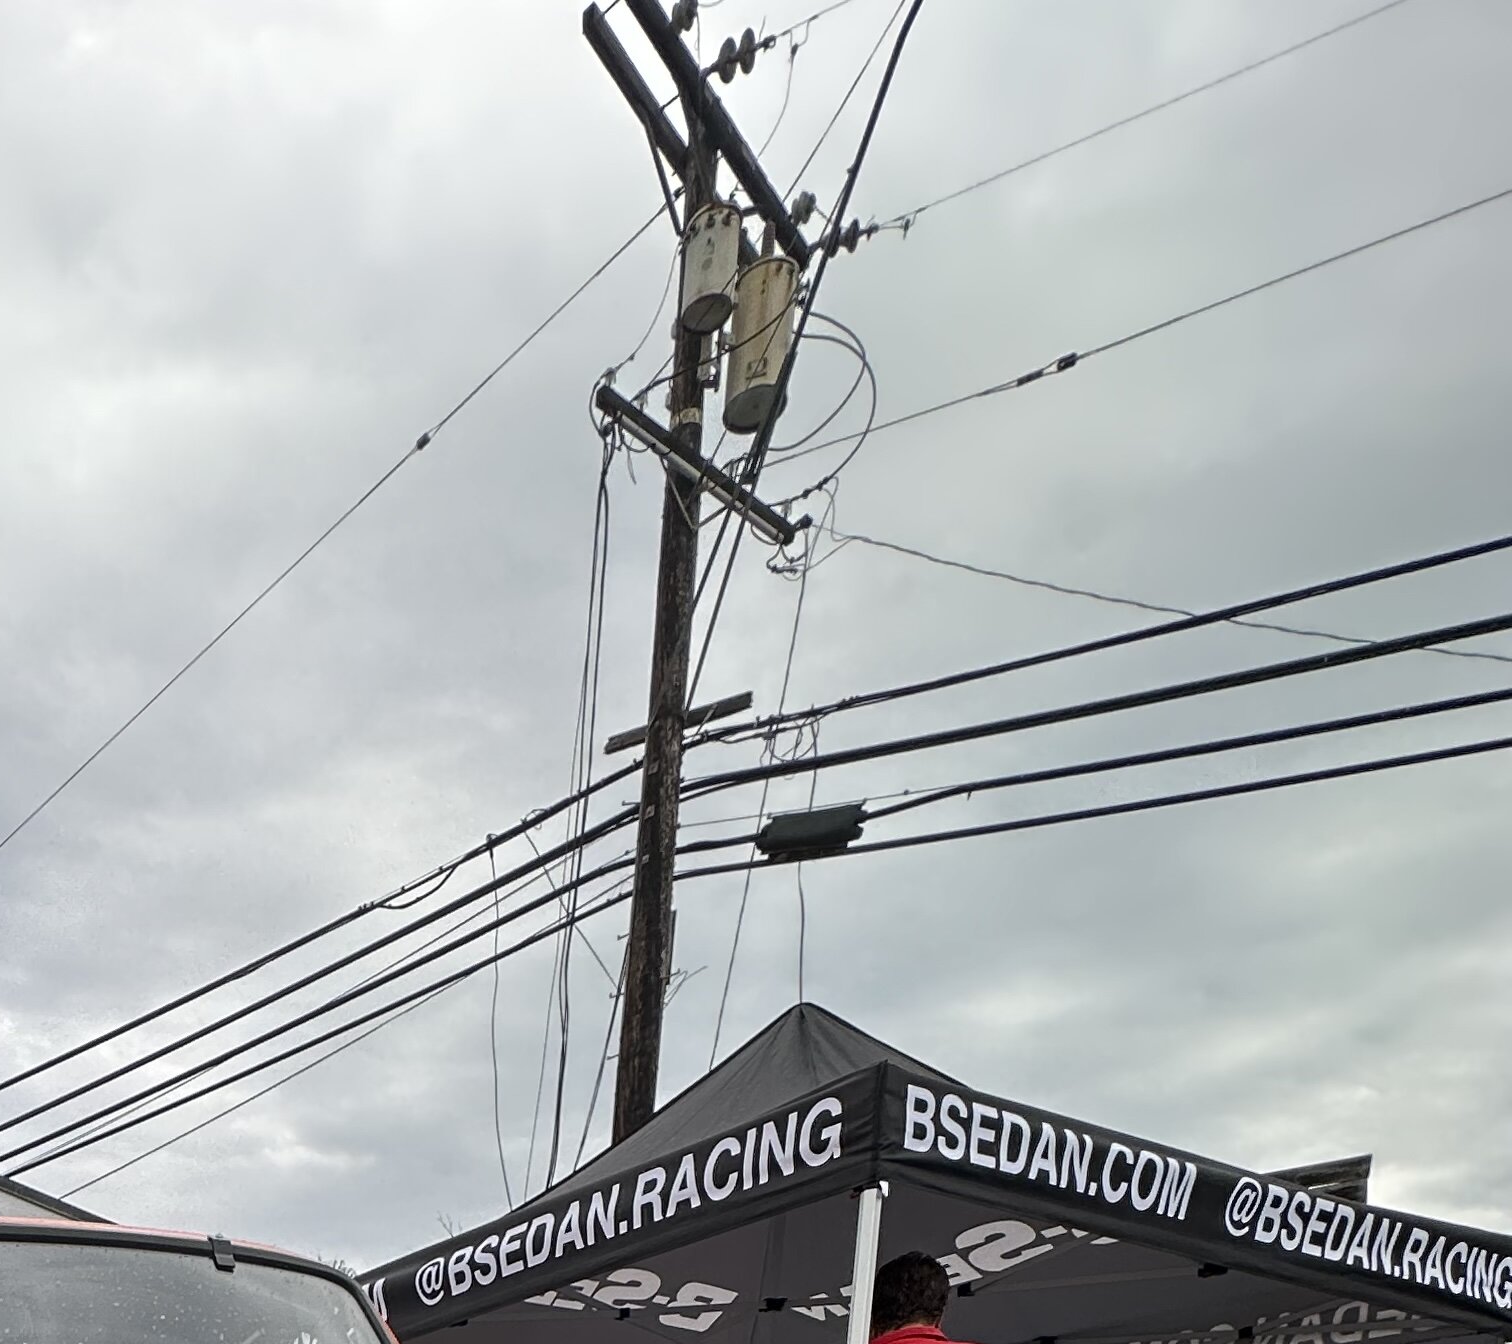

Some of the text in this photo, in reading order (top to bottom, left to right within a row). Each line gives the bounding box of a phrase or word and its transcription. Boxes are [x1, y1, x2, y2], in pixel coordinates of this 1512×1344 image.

[415, 1096, 843, 1306] @BSEDAN.RACING
[903, 1083, 1197, 1220] BSEDAN.COM
[1224, 1176, 1512, 1309] @BSEDAN.RACING
